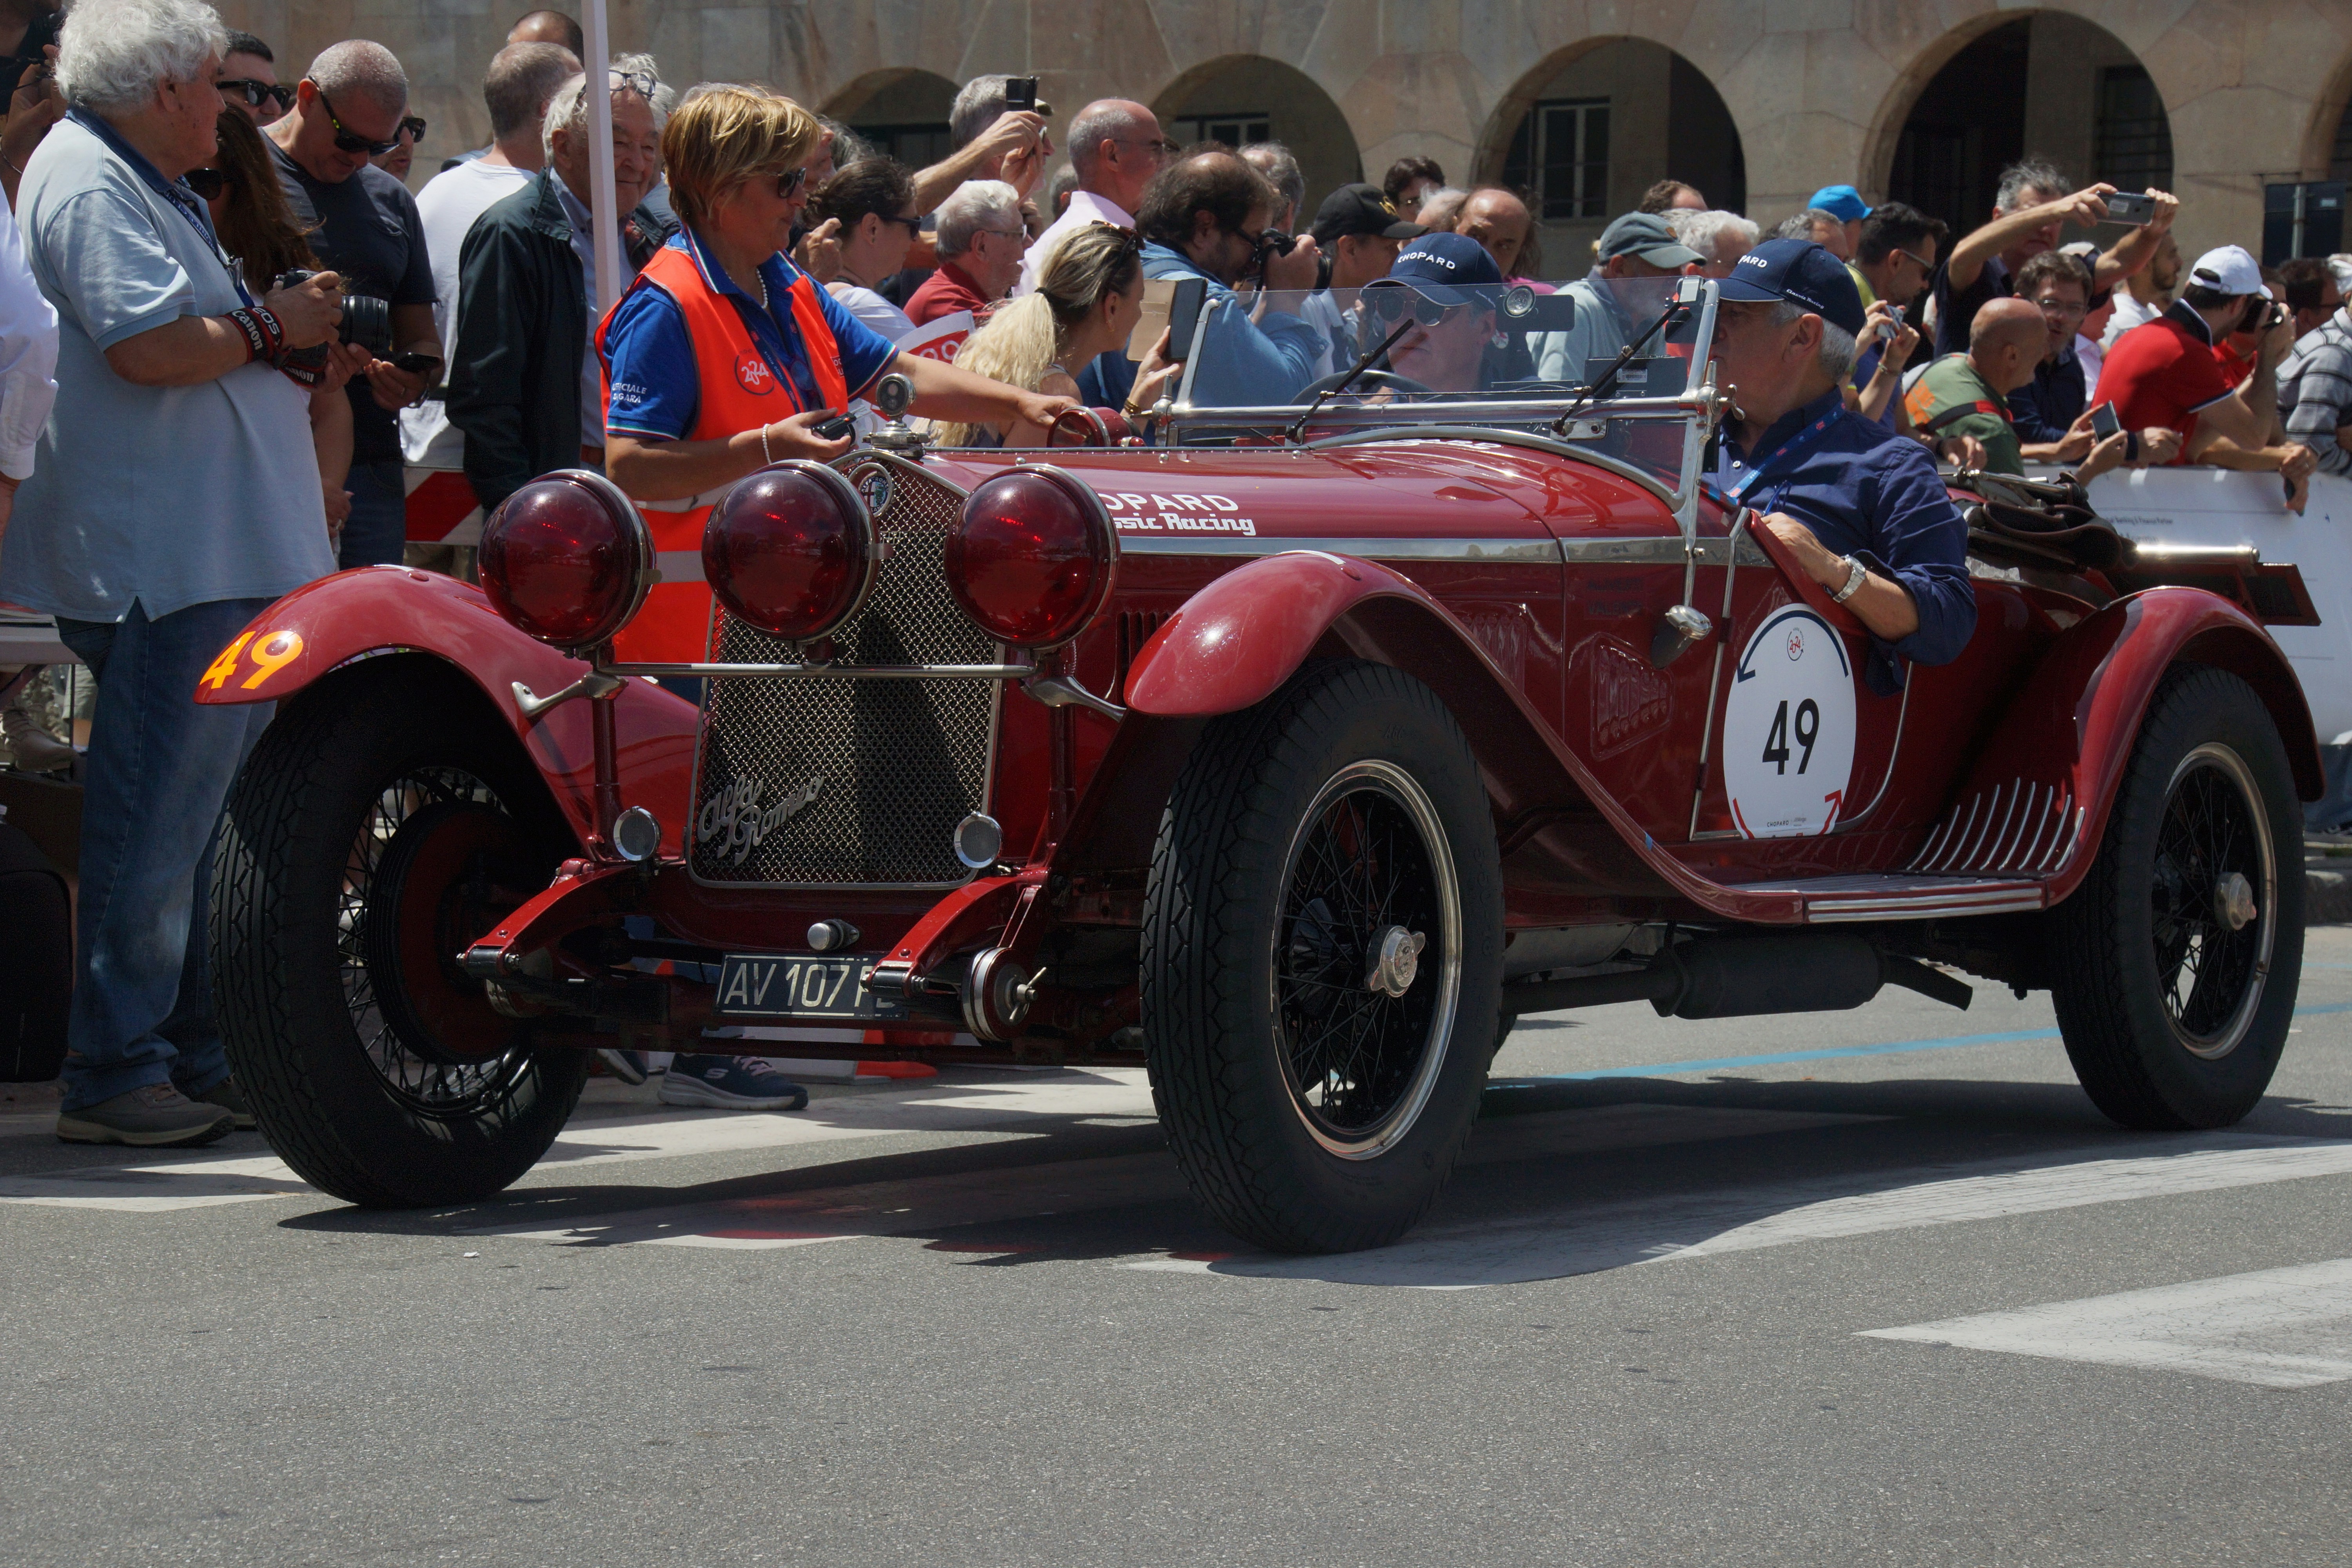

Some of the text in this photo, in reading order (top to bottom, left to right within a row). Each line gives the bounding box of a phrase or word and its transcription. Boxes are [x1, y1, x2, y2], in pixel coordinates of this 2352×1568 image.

[1397, 251, 1455, 270] CHOPARD
[1738, 254, 1768, 268] PARD
[232, 310, 263, 350] Canon
[252, 307, 280, 335] EOS
[285, 367, 314, 383] non
[741, 360, 769, 385] 2024
[618, 393, 641, 403] GARA
[1098, 493, 1239, 510] OPARD
[1114, 512, 1256, 535] ssic Racing
[1789, 635, 1801, 653] 2024
[200, 630, 303, 690] 49
[1762, 698, 1820, 775] 49
[731, 775, 824, 866] Romeo
[724, 963, 777, 1005] AV
[785, 964, 850, 1007] 107
